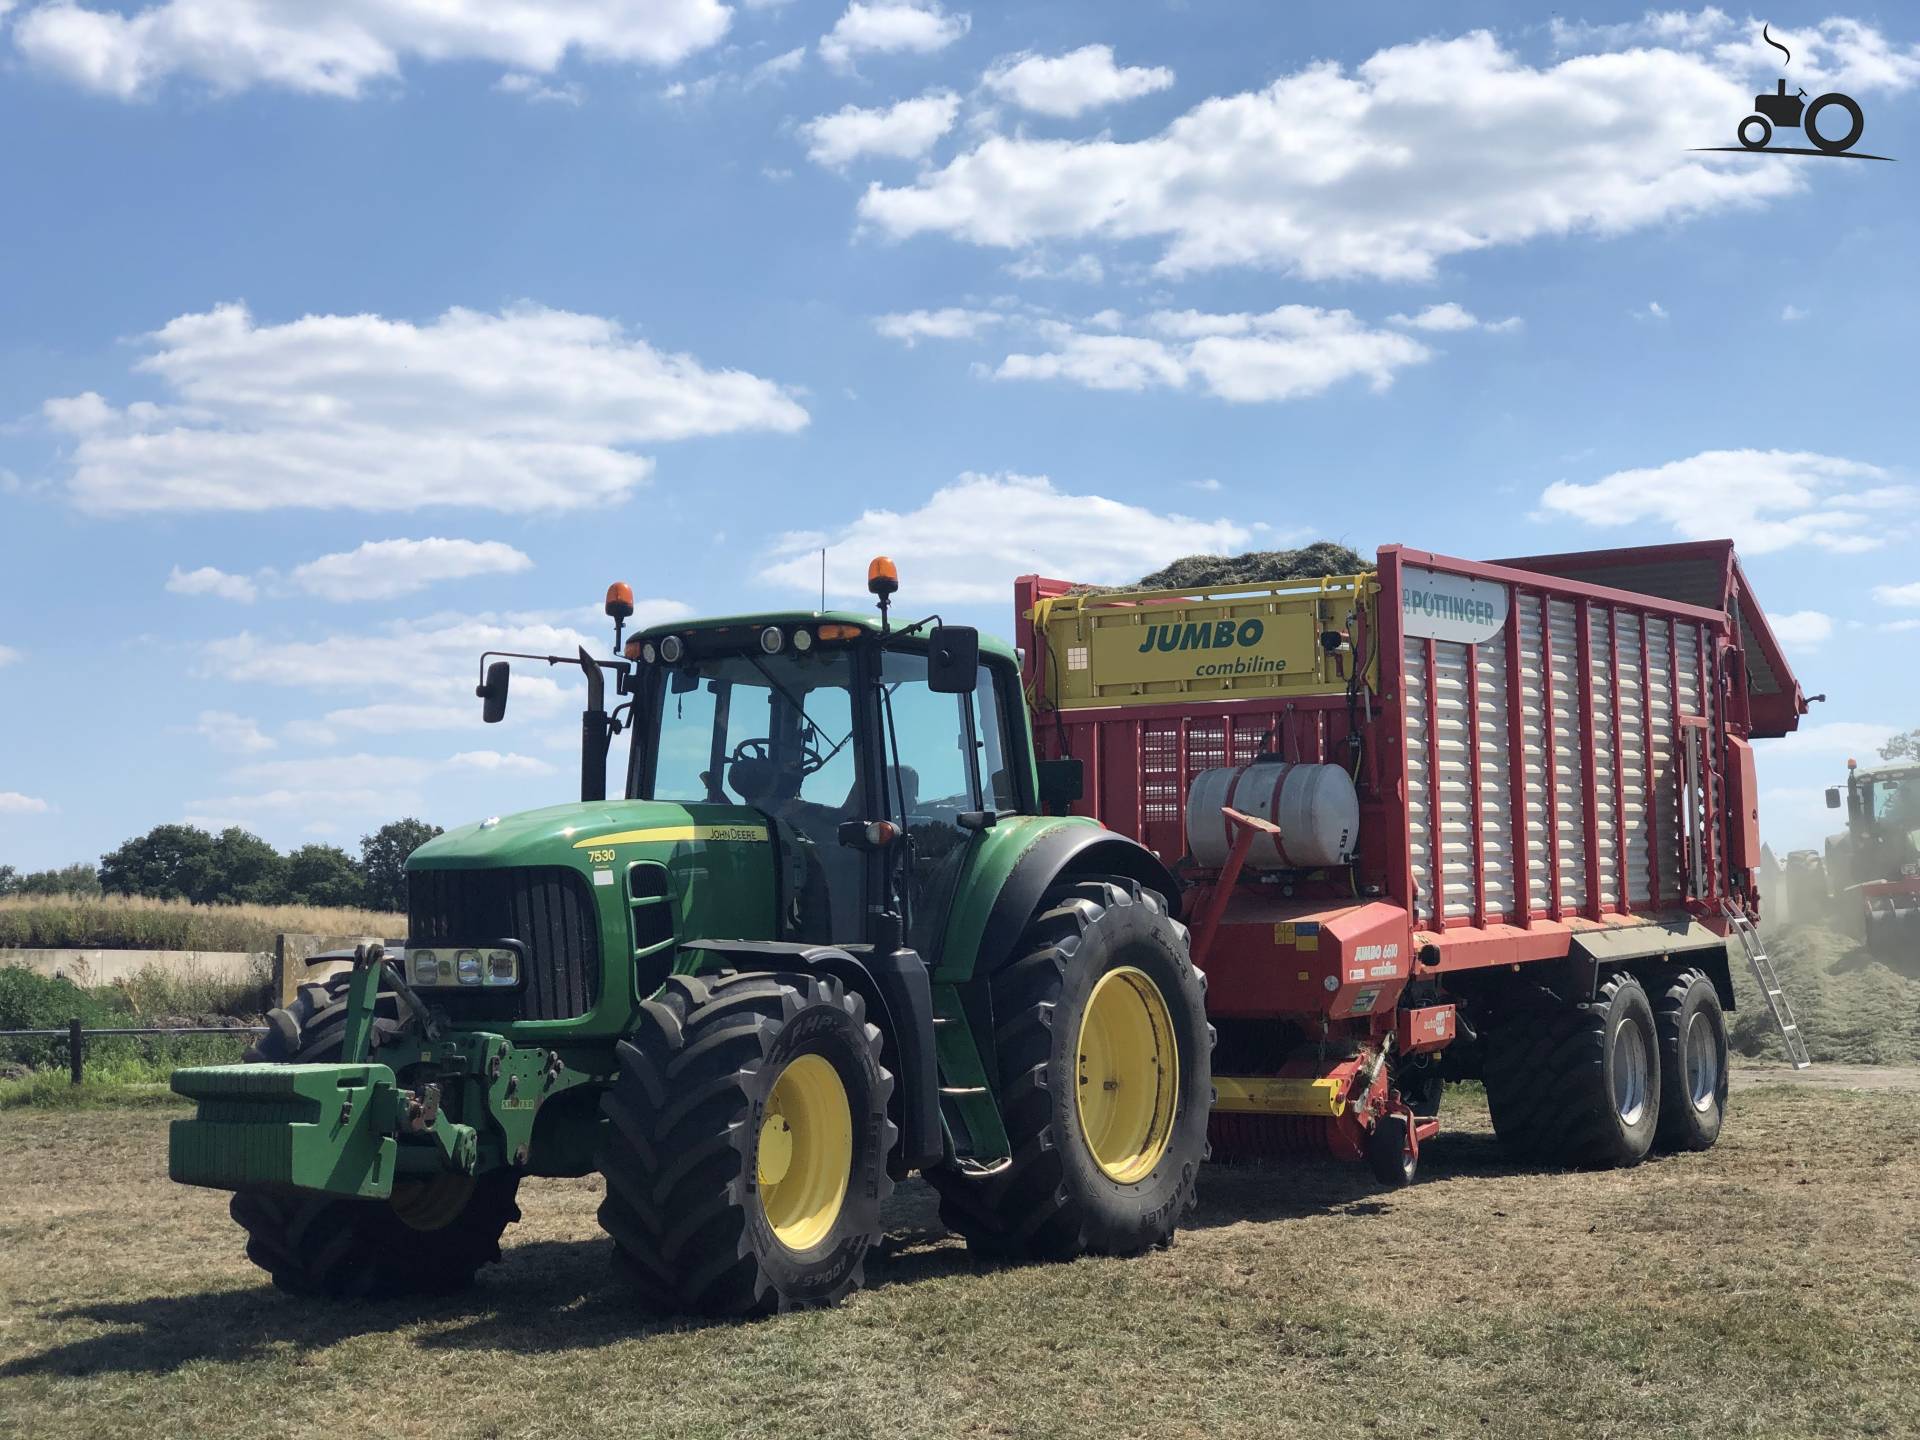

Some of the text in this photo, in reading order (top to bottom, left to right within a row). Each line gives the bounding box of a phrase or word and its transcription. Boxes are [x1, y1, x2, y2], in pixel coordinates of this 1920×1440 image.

[1138, 618, 1265, 653] JUMBO
[1195, 655, 1287, 677] combiline
[587, 849, 616, 863] 7530
